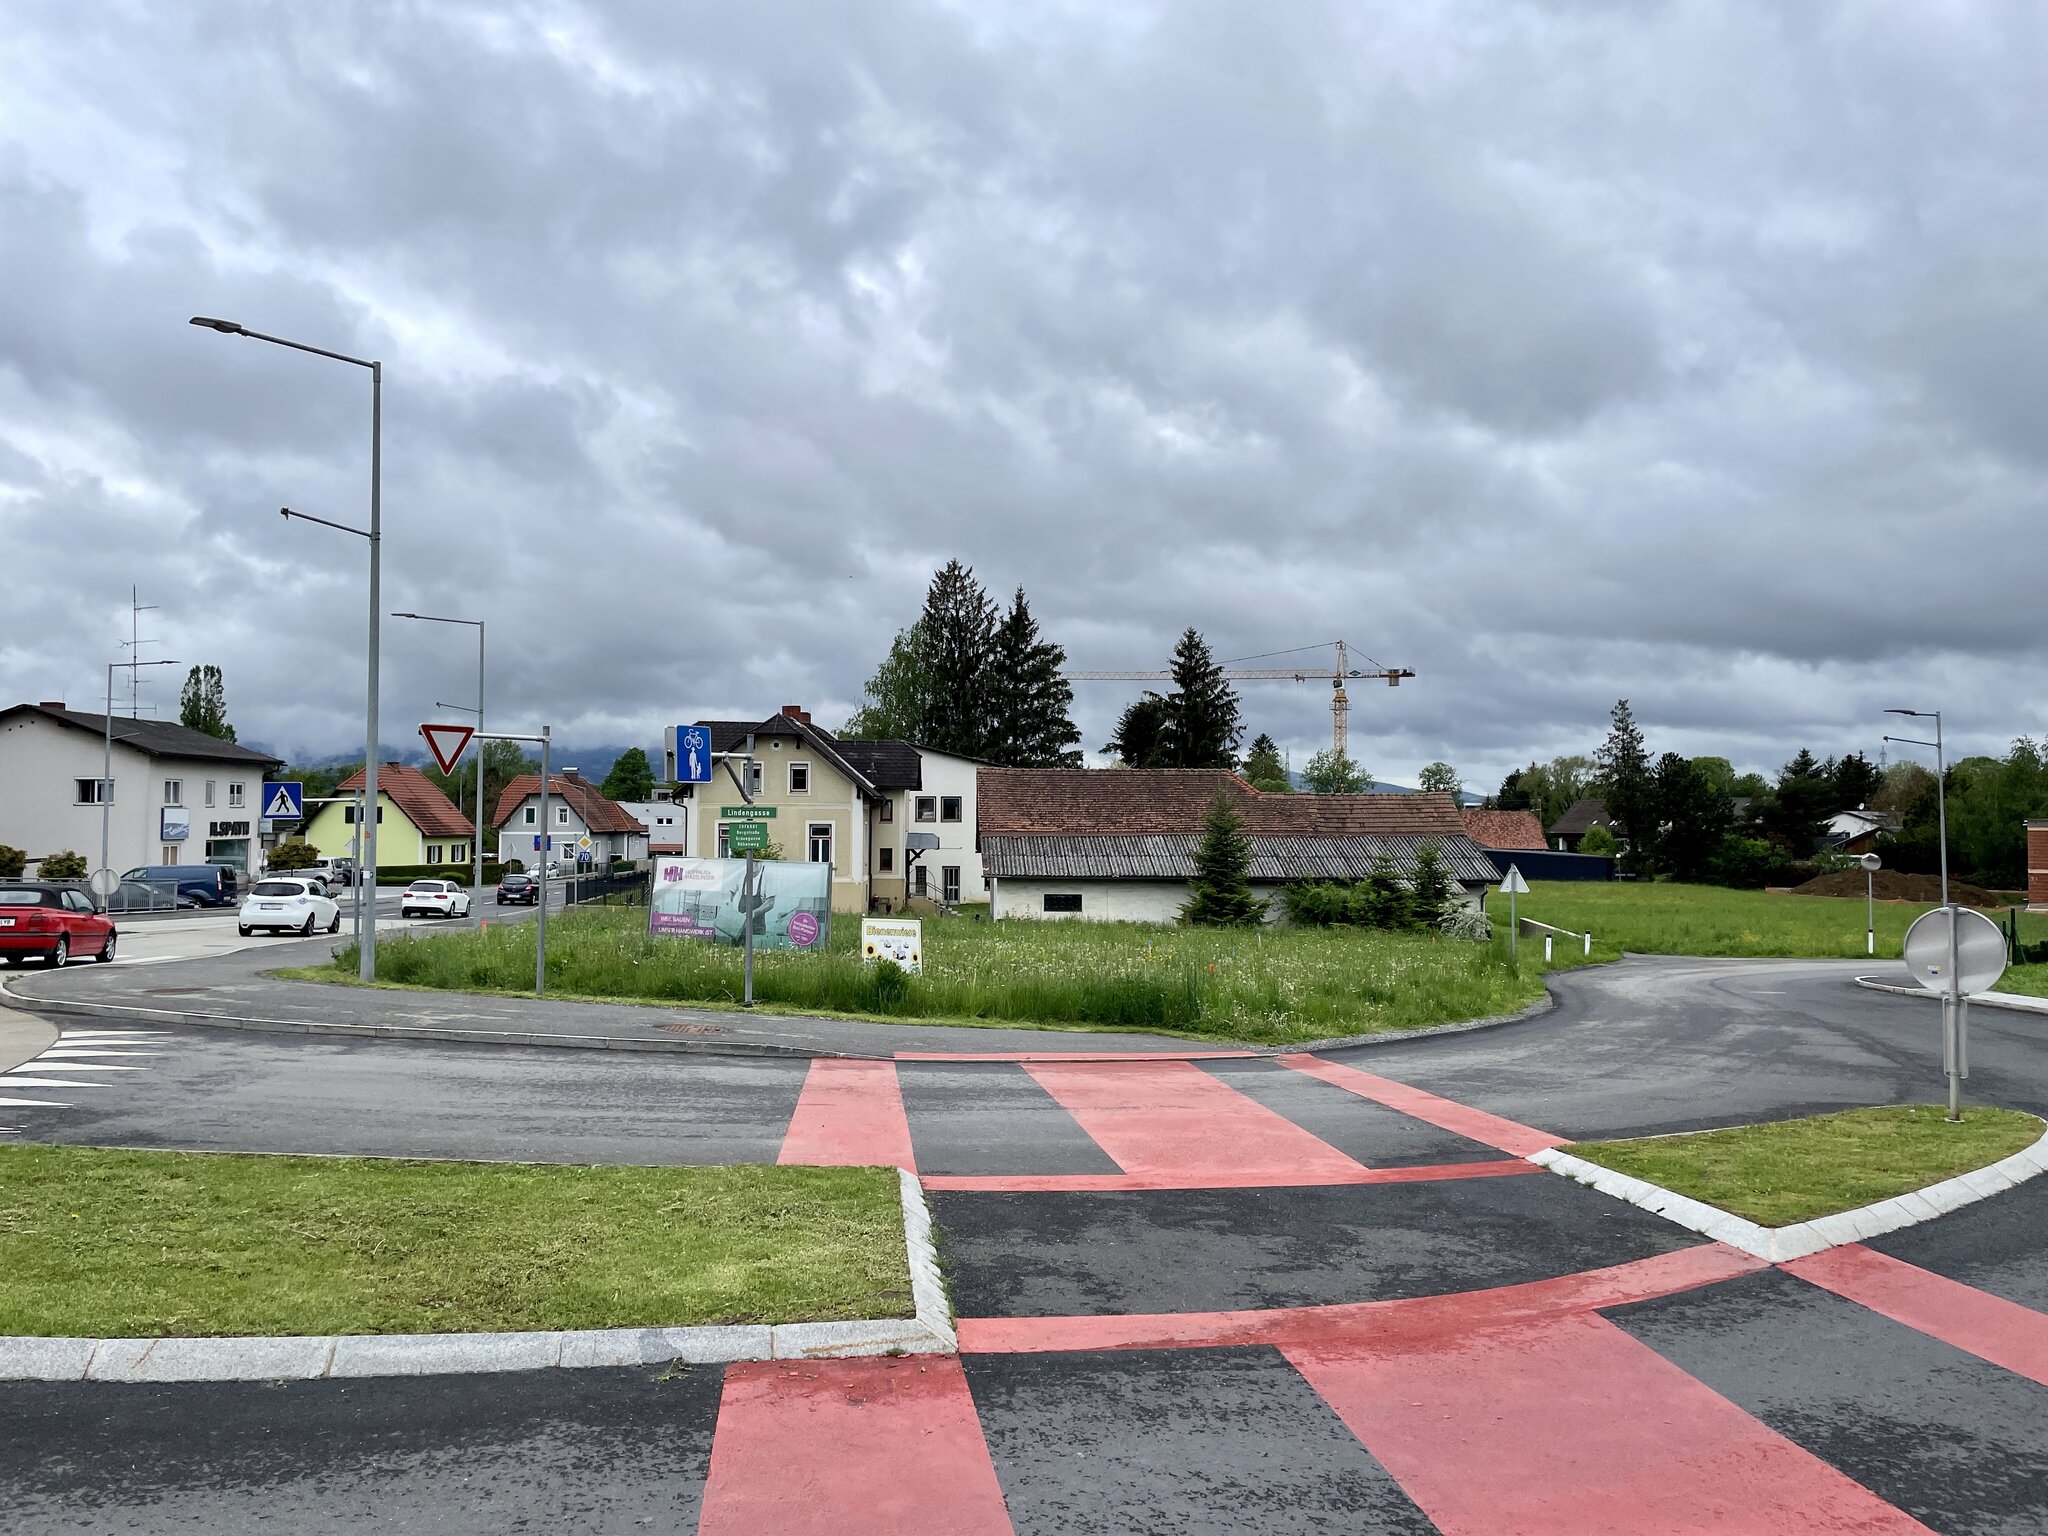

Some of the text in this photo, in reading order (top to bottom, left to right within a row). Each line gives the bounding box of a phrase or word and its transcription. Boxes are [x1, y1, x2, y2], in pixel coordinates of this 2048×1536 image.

[727, 809, 770, 818] Lindengasse
[580, 852, 589, 861] 70
[866, 925, 917, 938] Bienenwiese
